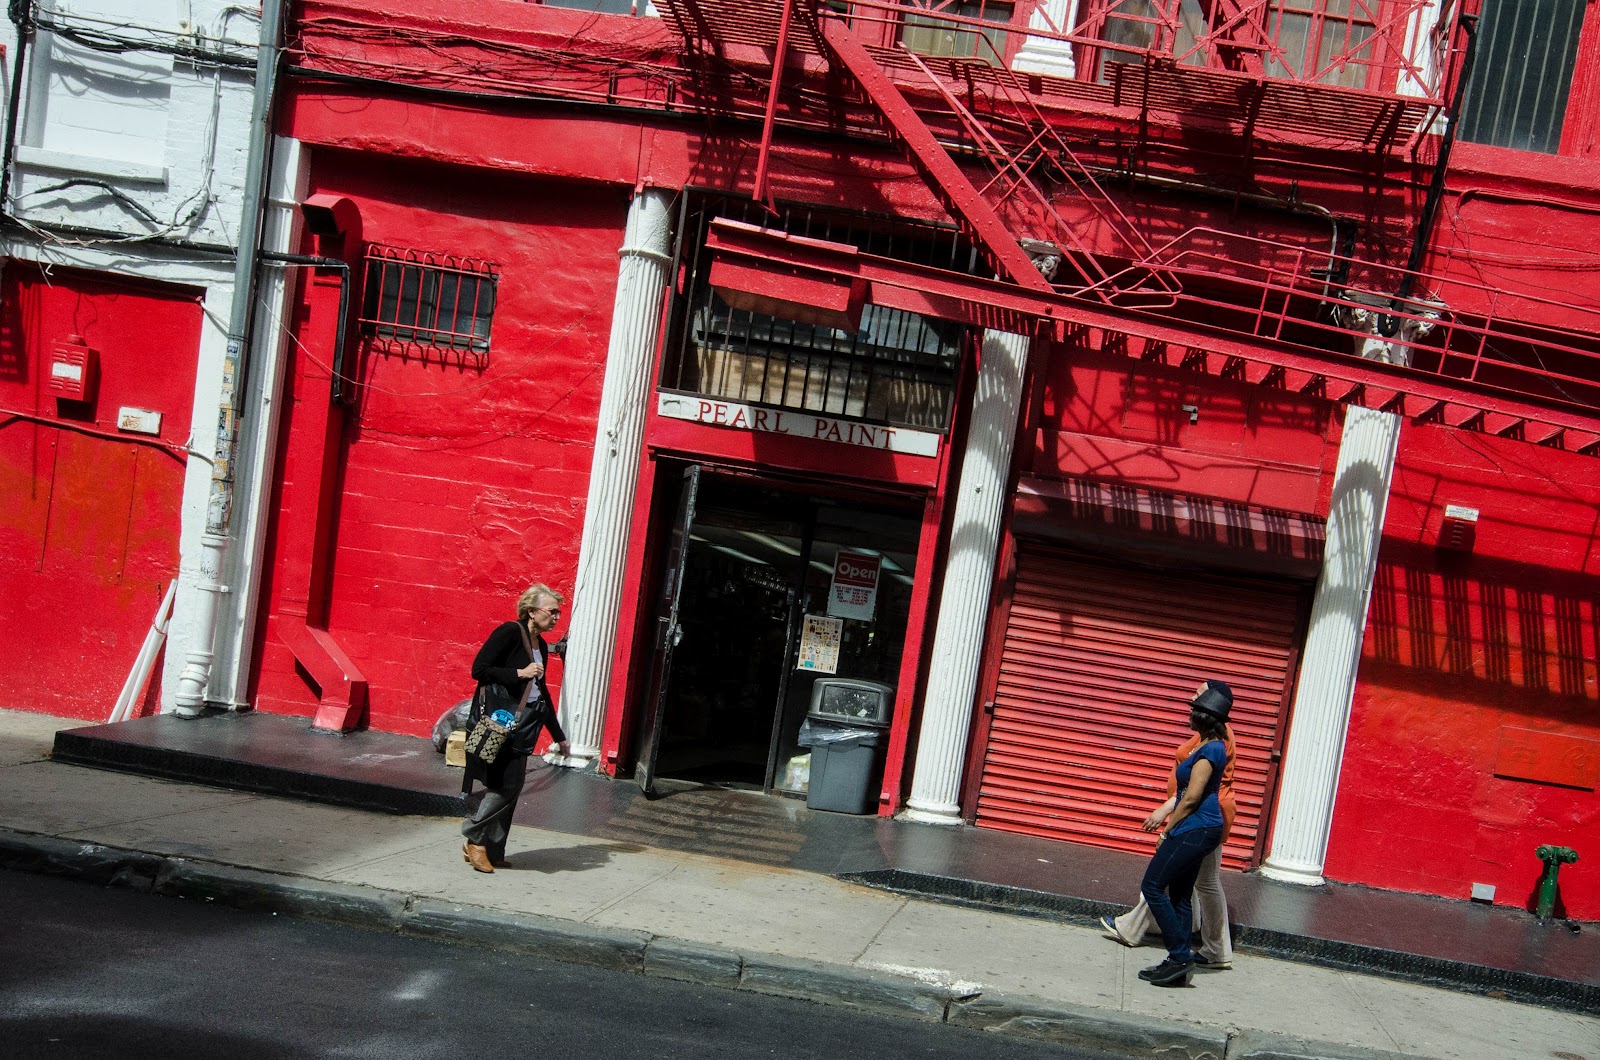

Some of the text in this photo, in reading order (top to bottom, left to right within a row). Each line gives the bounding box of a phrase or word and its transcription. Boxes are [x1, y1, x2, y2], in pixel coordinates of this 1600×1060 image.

[697, 400, 897, 450] PEARL PAINT
[838, 561, 877, 580] Open
